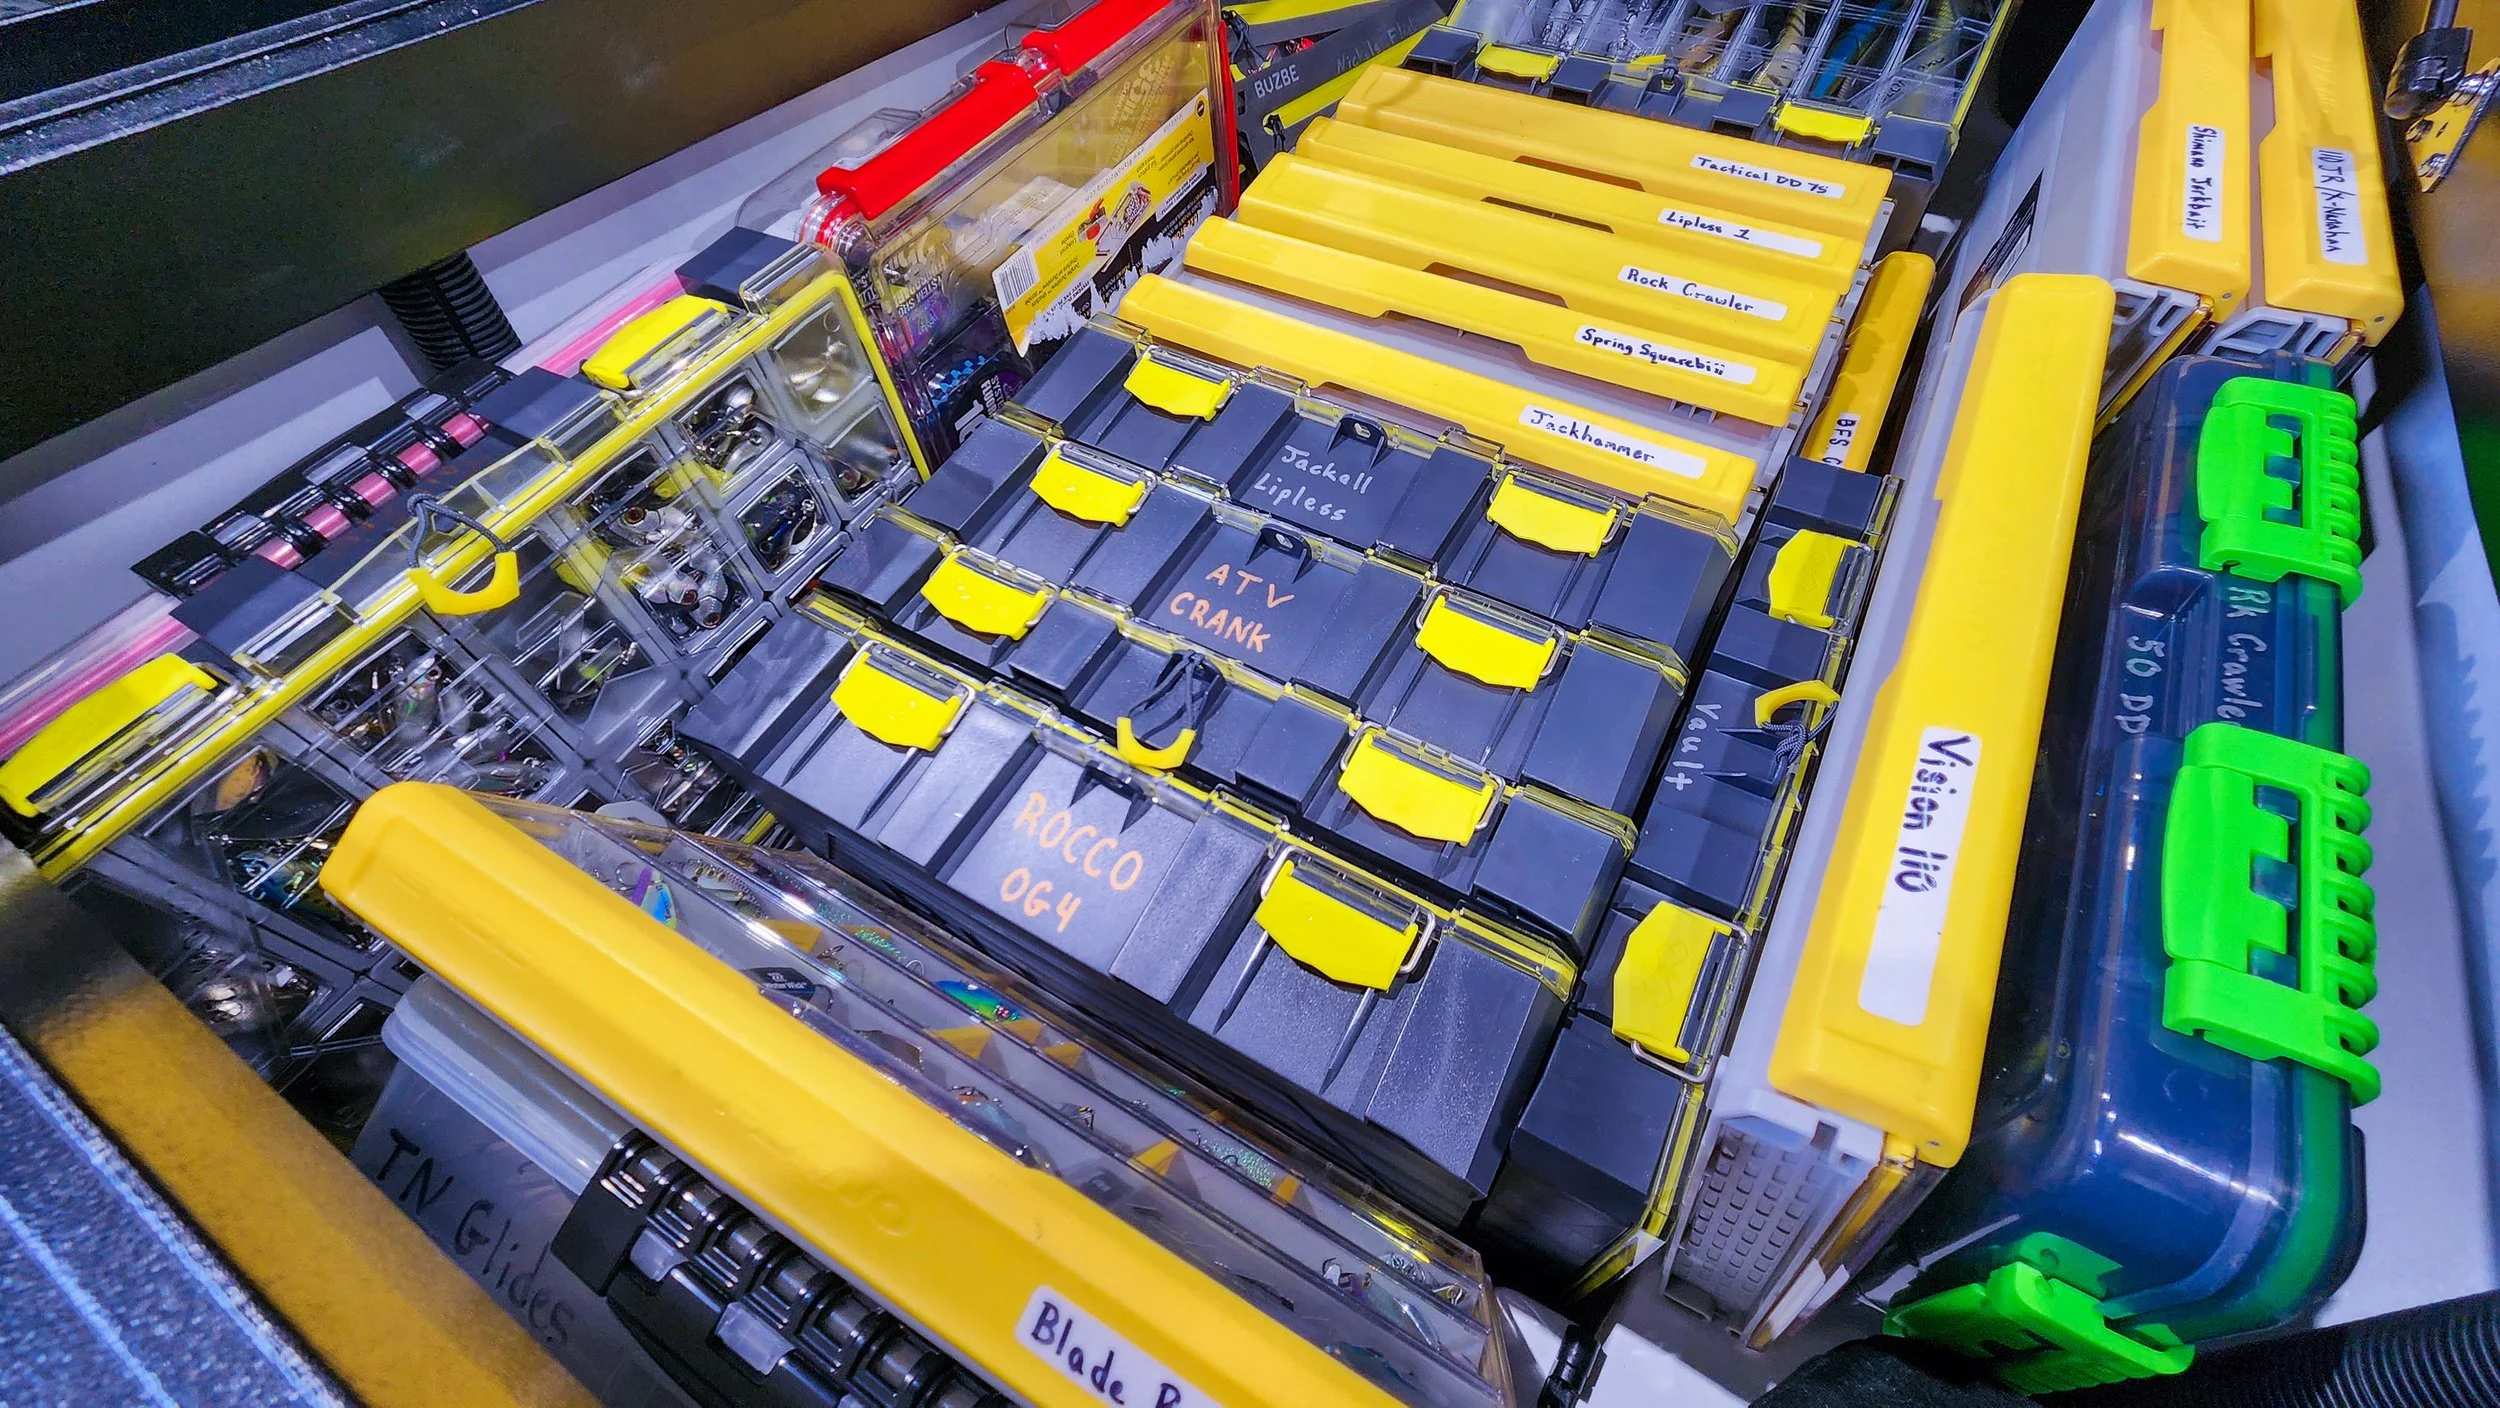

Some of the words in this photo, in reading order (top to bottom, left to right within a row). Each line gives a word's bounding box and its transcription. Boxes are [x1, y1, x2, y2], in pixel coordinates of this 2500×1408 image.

[1254, 65, 1300, 99] BUZBE
[2190, 126, 2217, 167] Shimano
[1698, 156, 1768, 181] Tactical
[1776, 175, 1802, 188] DD
[1808, 182, 1828, 194] 75
[1667, 211, 1722, 234] Lipless
[1734, 229, 1750, 240] 1
[1627, 268, 1668, 290] Rock
[1682, 282, 1754, 312] Crawler
[1582, 328, 1633, 355] Spring
[1530, 409, 1655, 462] Jackhammer
[1826, 417, 1857, 447] BFS
[1281, 444, 1373, 494] Jackall
[1253, 472, 1347, 521] Lipless
[1205, 563, 1295, 609] ATV
[1170, 592, 1271, 652] CRANK
[2125, 635, 2165, 678] 50
[2216, 633, 2268, 726] Crawle
[2114, 692, 2154, 734] DD
[1664, 702, 1722, 792] Vault
[1903, 735, 1973, 830] Vision
[1013, 791, 1144, 891] ROCCO
[1000, 867, 1082, 933] OG4
[376, 1128, 455, 1217] TN
[454, 1199, 575, 1346] Glides
[1031, 1301, 1125, 1405] Blade
